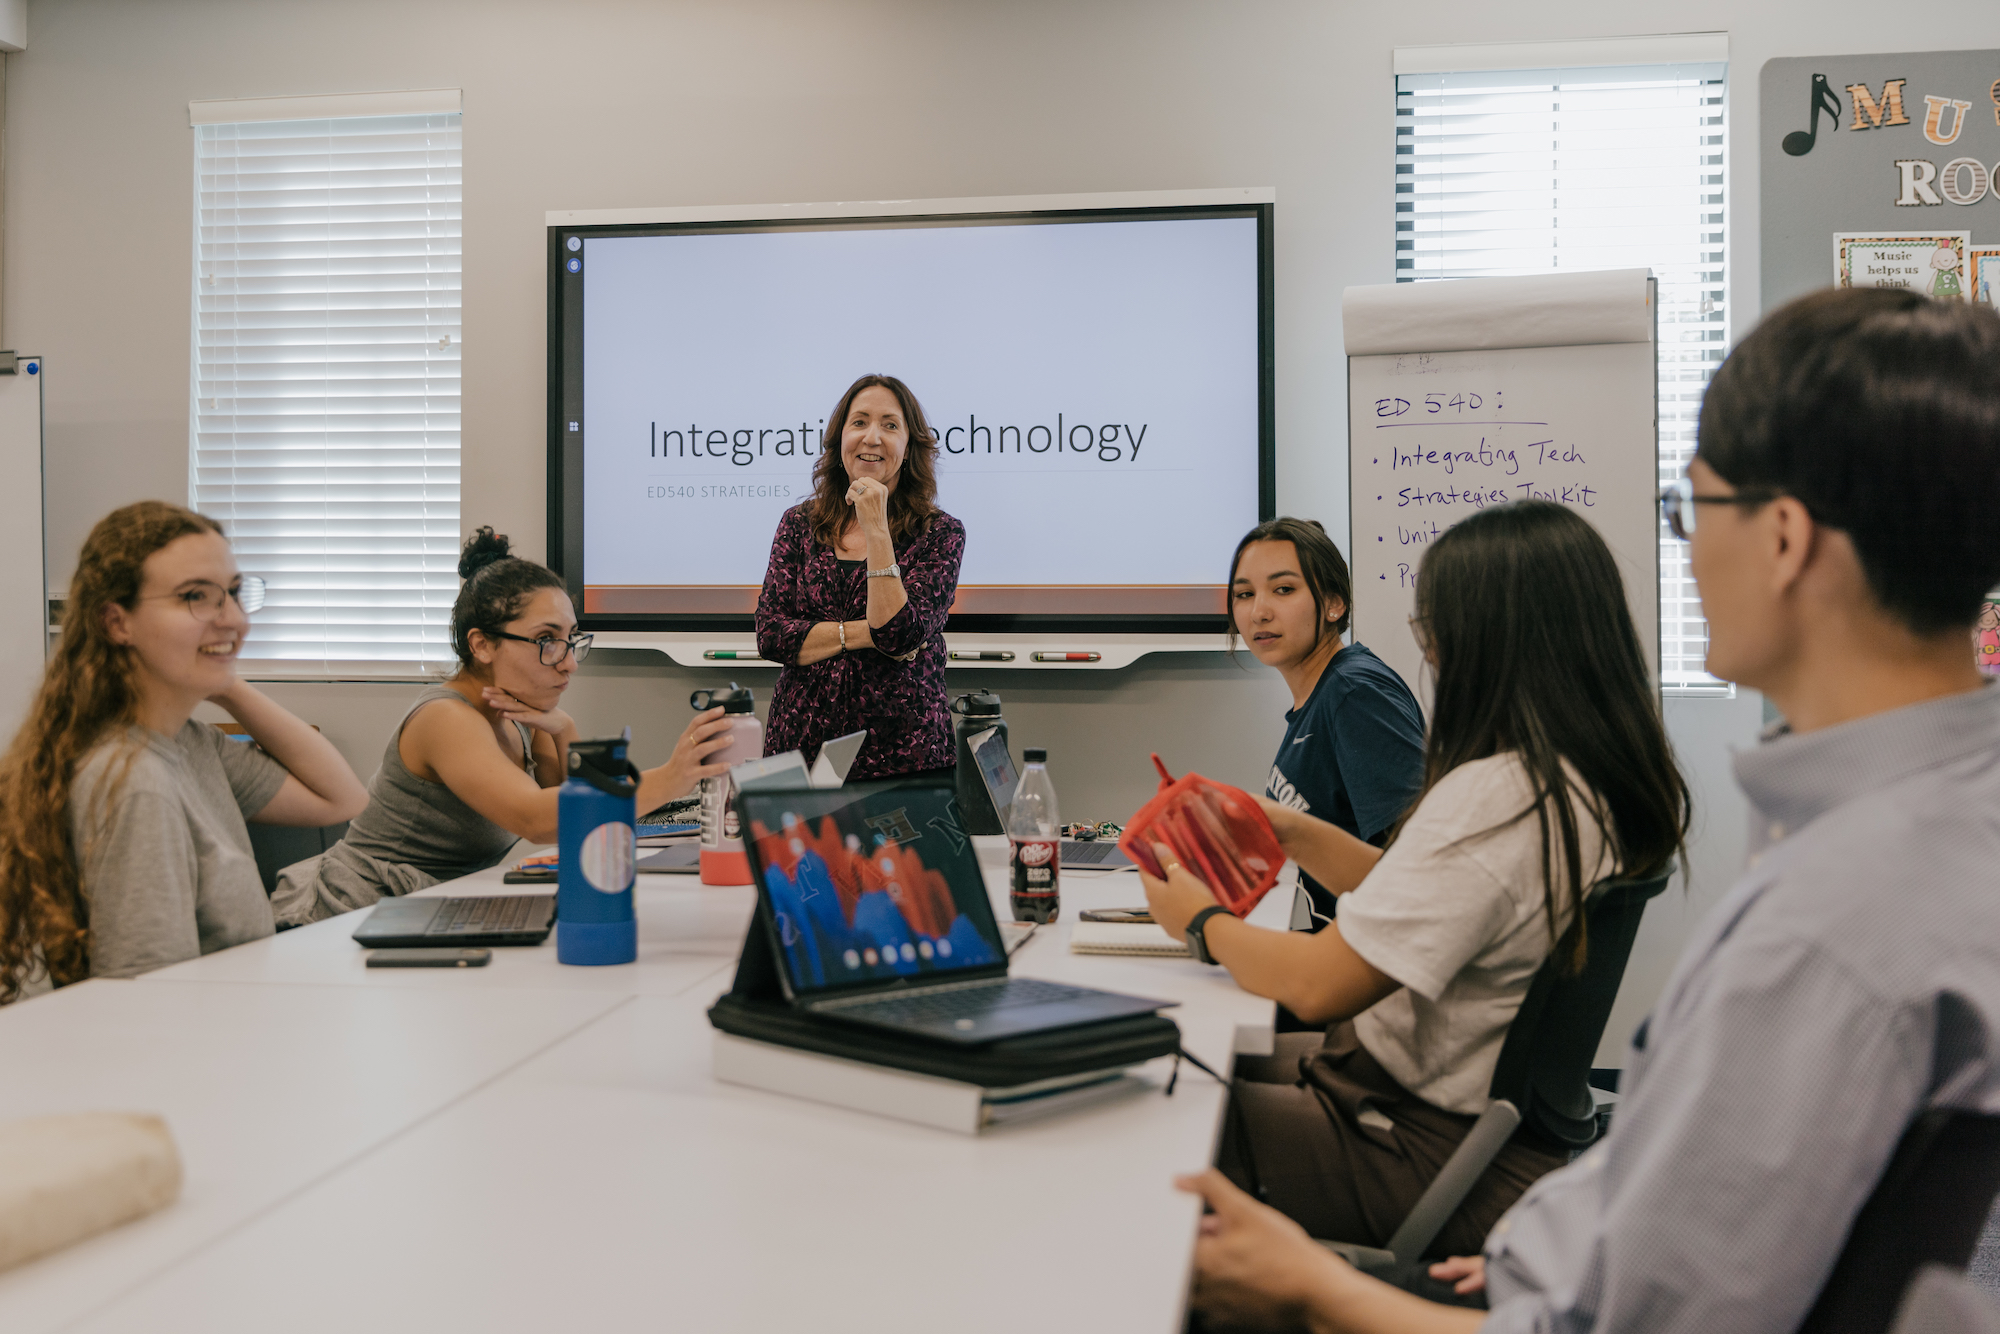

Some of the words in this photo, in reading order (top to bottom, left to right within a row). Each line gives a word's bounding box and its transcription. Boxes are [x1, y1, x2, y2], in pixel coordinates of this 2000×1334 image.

[1873, 250, 1913, 261] Music
[1867, 264, 1902, 277] helps
[1904, 265, 1919, 275] us
[1875, 278, 1911, 288] think
[1375, 397, 1411, 417] ED
[651, 418, 824, 466] Integrati
[929, 412, 1148, 462] chnology
[1393, 437, 1519, 475] Integrating
[1528, 439, 1586, 466] Tech
[646, 486, 695, 499] ED540
[701, 485, 791, 498] STRATEGIES
[1398, 486, 1509, 509] Strategies
[1398, 520, 1441, 545] Unit
